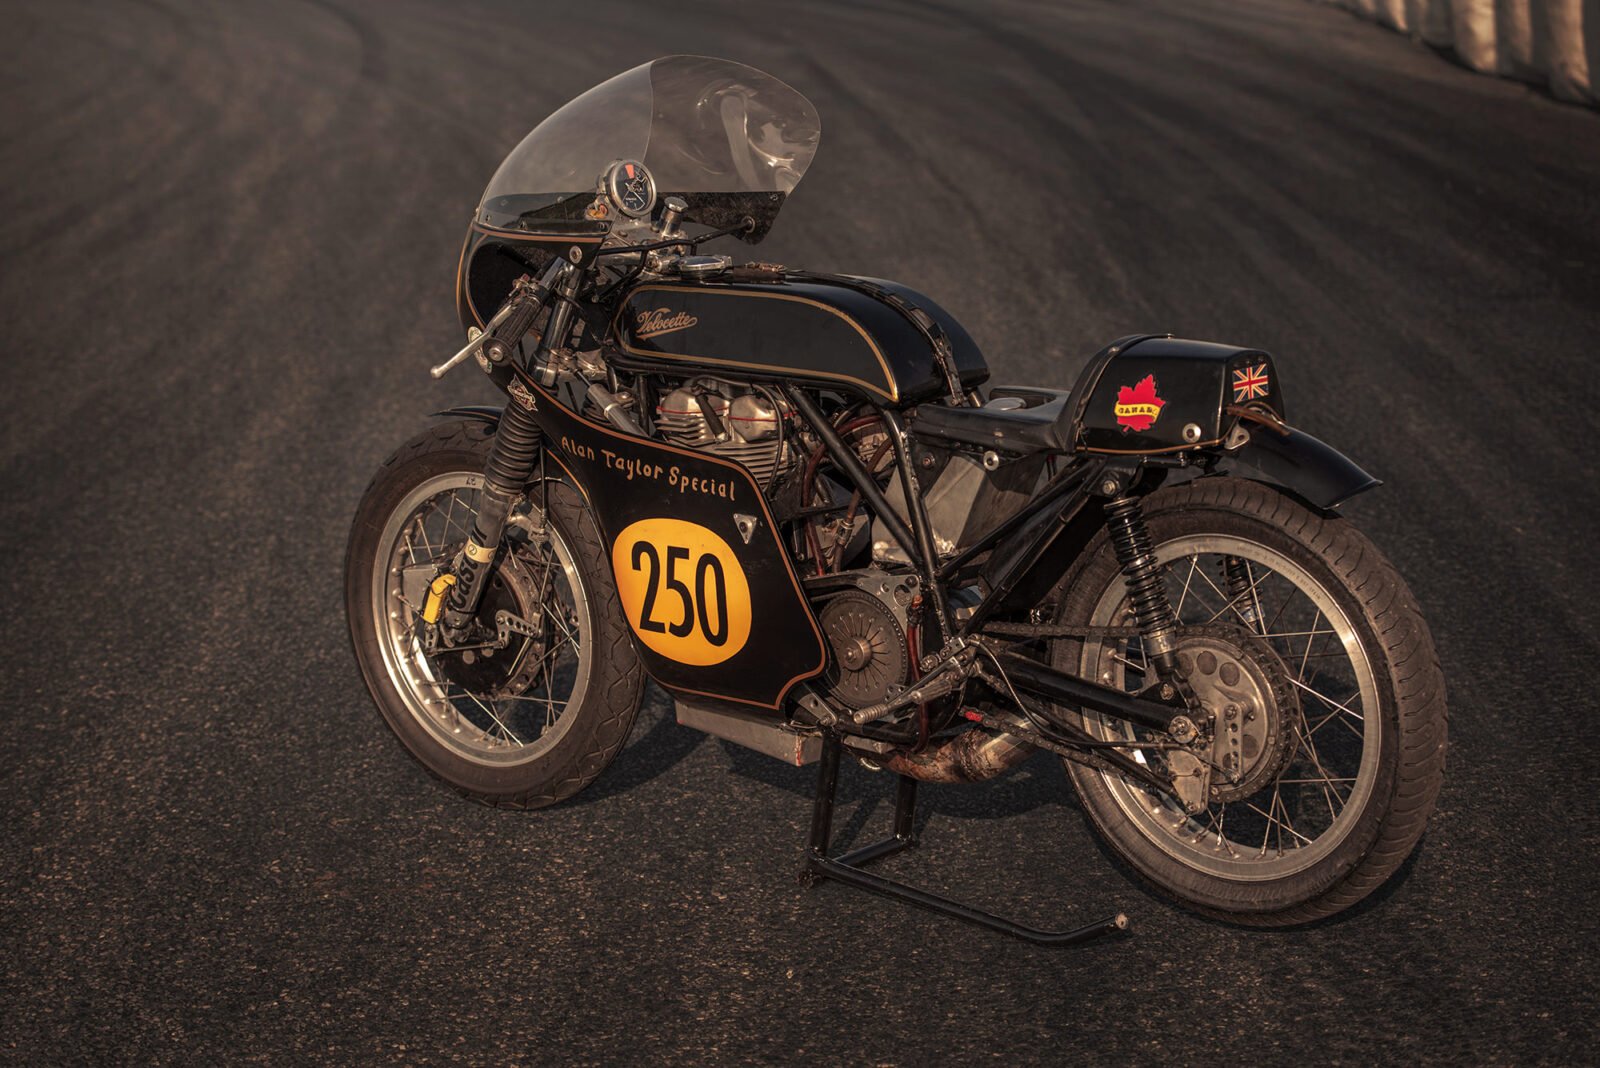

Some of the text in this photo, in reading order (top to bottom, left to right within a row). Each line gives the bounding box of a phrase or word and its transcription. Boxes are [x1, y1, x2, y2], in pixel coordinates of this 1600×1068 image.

[636, 307, 697, 337] Velocette
[561, 436, 736, 501] Alan Taylor Special
[631, 540, 729, 648] 250
